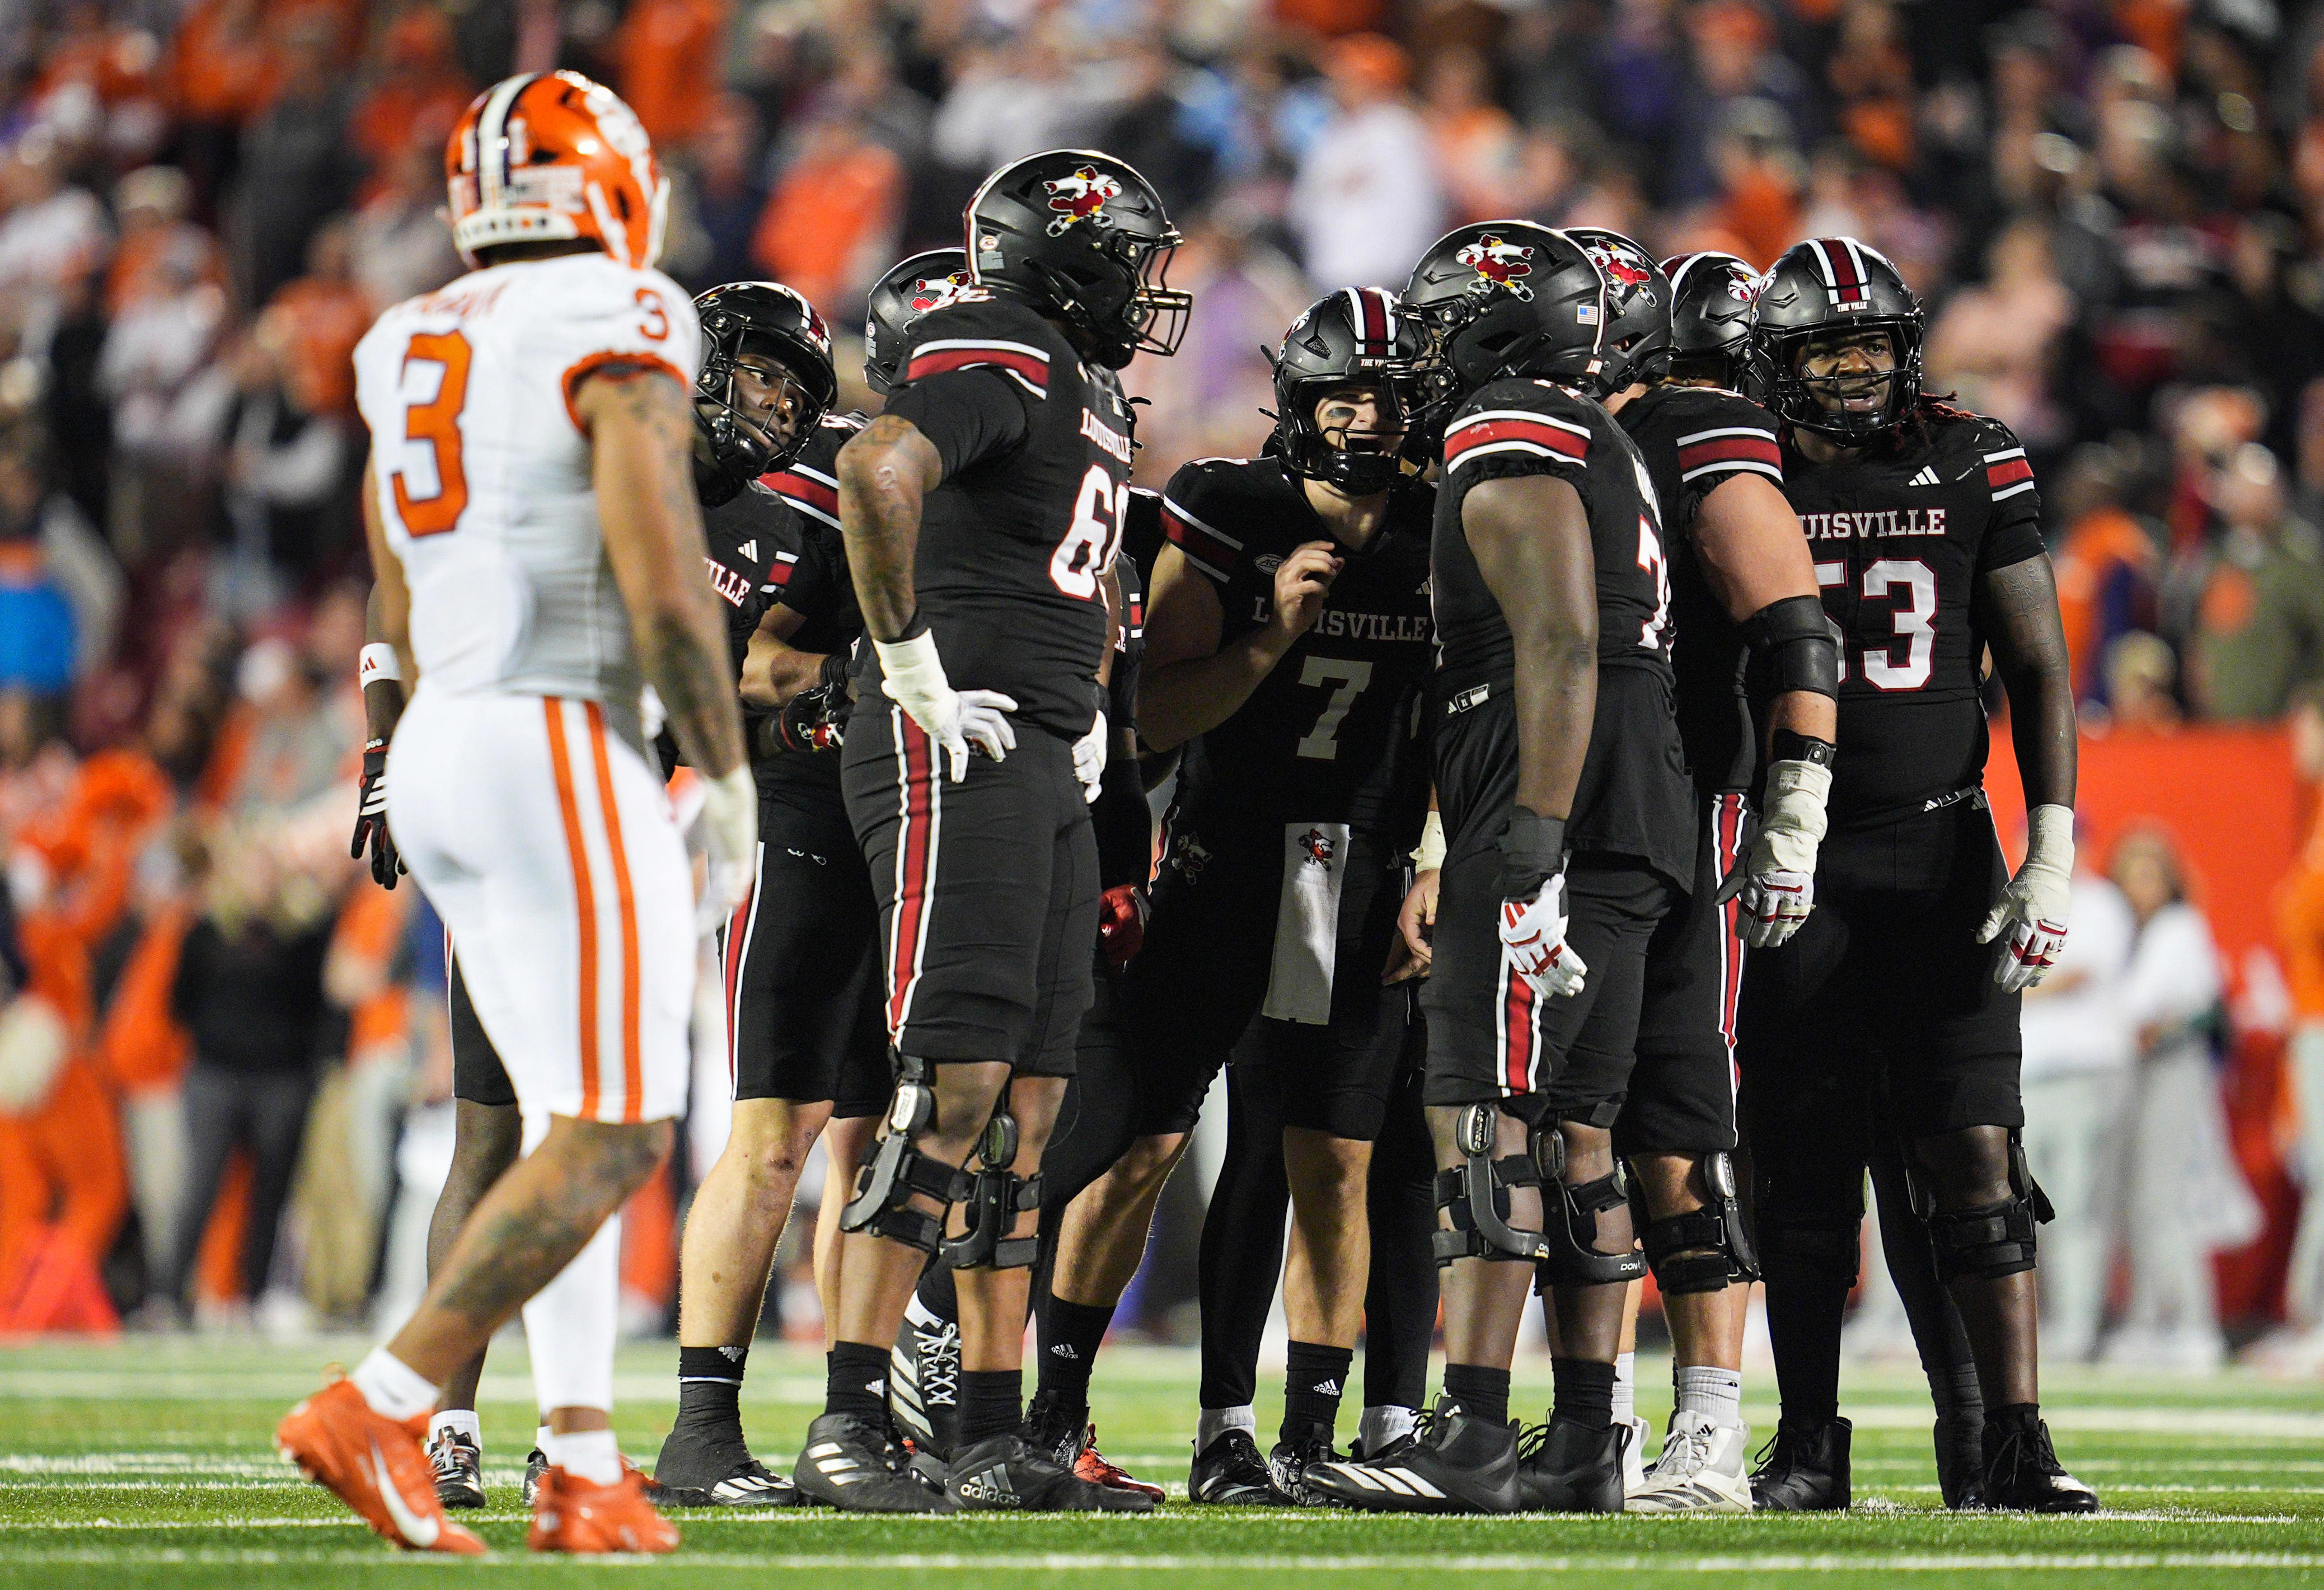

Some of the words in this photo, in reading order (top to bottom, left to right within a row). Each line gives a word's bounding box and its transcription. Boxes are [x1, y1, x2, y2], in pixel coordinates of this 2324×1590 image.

[635, 288, 669, 341] 3
[1837, 303, 1850, 312] THE
[1850, 301, 1868, 310] VILLE
[390, 328, 473, 538] 3
[1796, 509, 1946, 541] UISVILLE
[1252, 596, 1428, 642] LISVILLE
[1297, 655, 1374, 760] 7
[1051, 1347, 1079, 1359] adidas
[1313, 1386, 1340, 1396] adidas
[960, 1483, 1021, 1505] adidas
